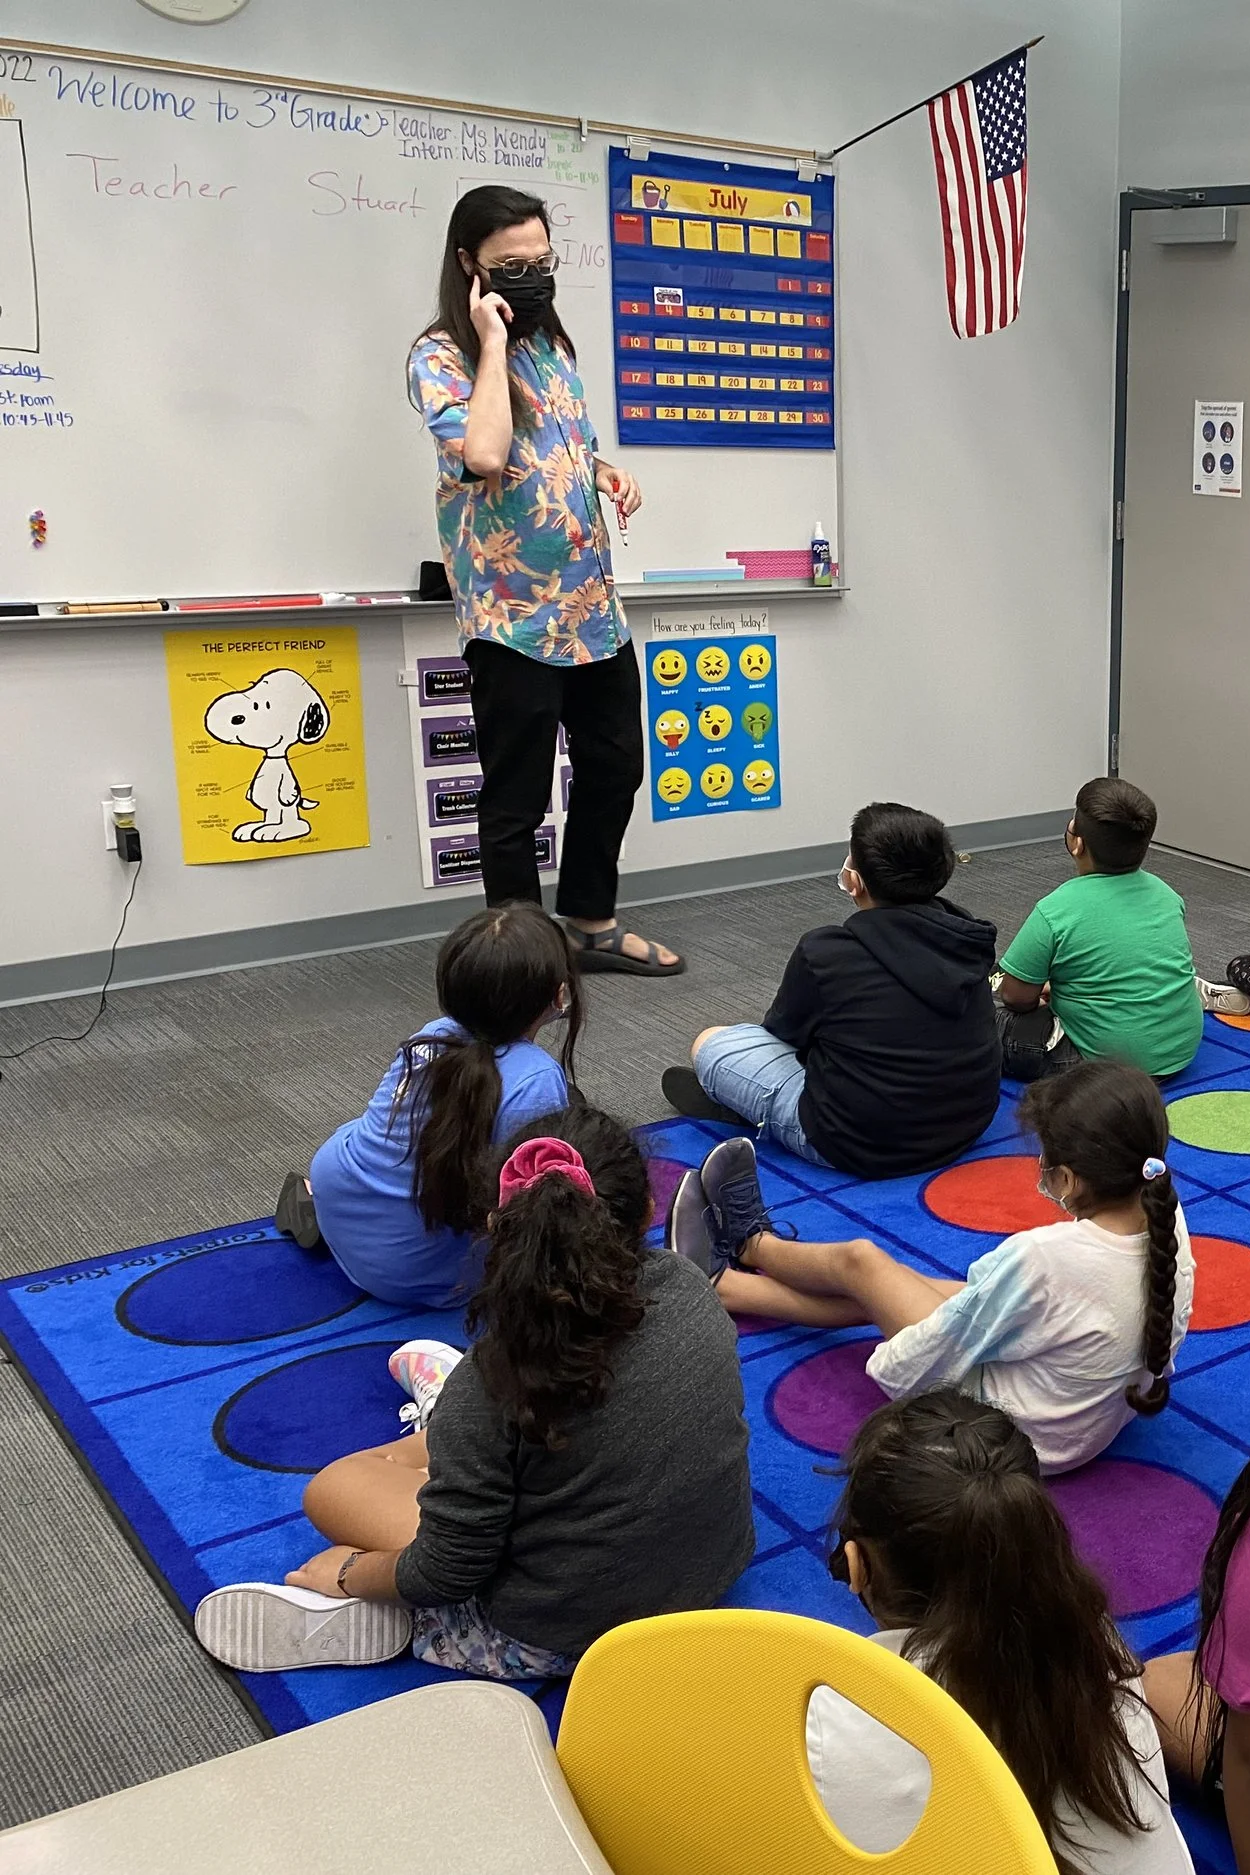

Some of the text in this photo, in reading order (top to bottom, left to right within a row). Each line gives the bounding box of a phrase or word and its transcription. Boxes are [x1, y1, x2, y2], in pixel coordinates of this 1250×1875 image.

[49, 66, 195, 120] Welcome
[208, 90, 238, 122] to
[494, 127, 546, 160] Wendy
[495, 150, 543, 168] Daniela
[66, 153, 427, 218] Teacher Stuart
[708, 188, 748, 216] July
[630, 338, 823, 358] 10 11 12 13 14 15 16
[631, 373, 823, 391] 17 18 19 20 21 22 23
[630, 407, 824, 423] 24 25 26 27 28 29 30
[653, 612, 767, 636] How are you feeling today?
[202, 639, 327, 654] THE PERFECT FRIEND
[706, 800, 729, 808] CURIOUS
[160, 1229, 267, 1260] Carpets
[119, 1255, 157, 1270] for
